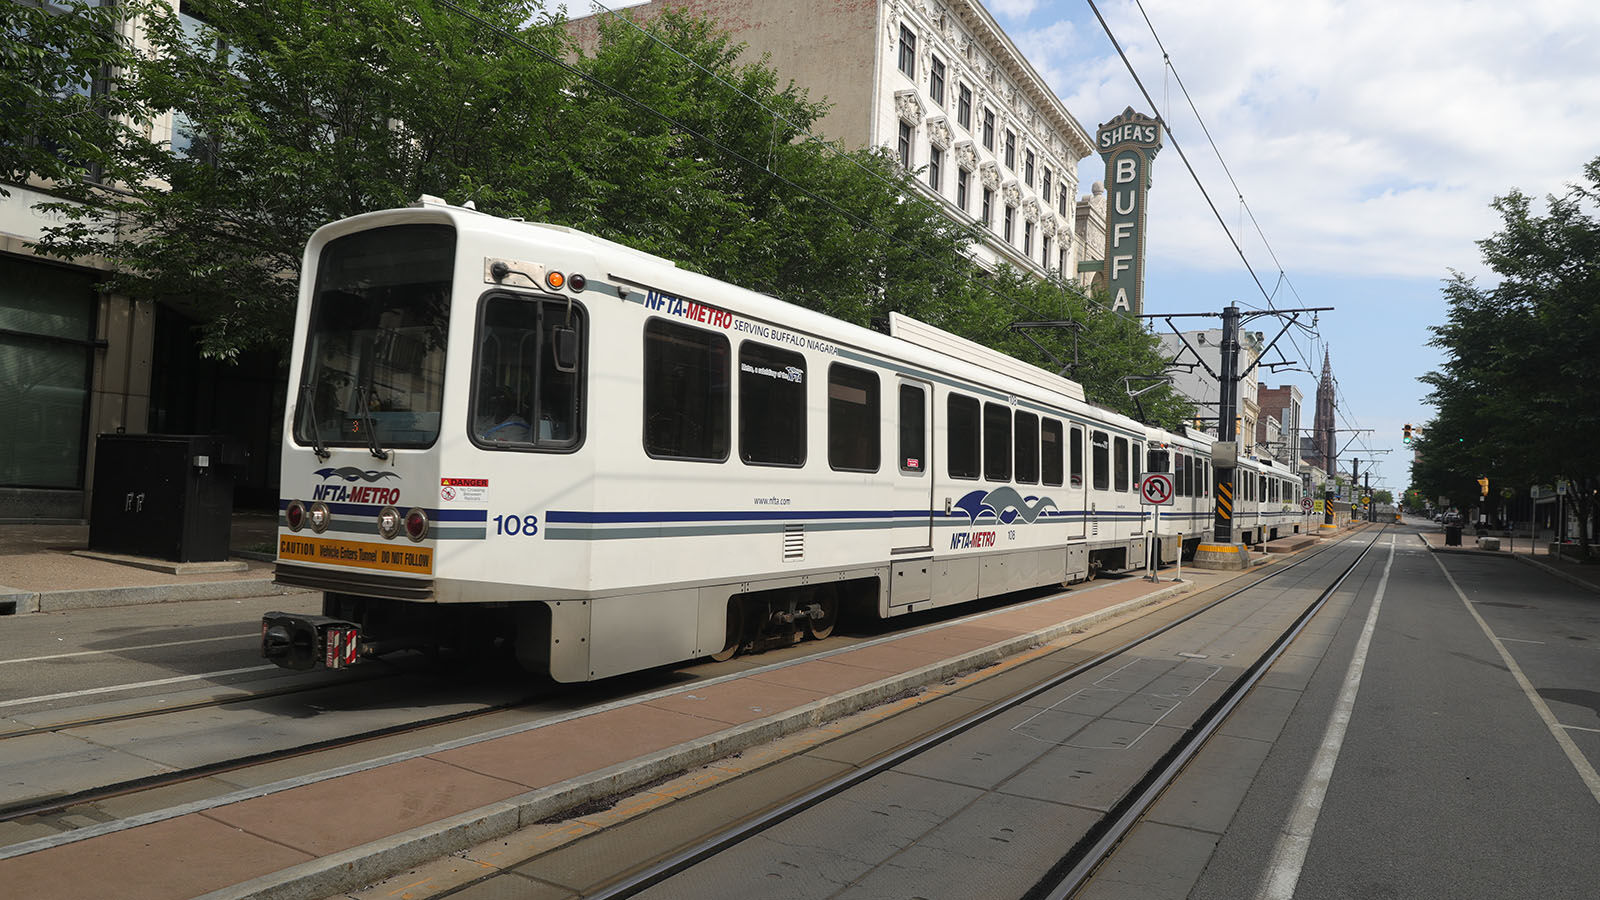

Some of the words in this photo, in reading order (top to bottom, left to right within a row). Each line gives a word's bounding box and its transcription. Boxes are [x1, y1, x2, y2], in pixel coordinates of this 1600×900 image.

[1101, 125, 1155, 147] SHEA'S
[645, 289, 733, 329] NFTA-METRO
[734, 319, 770, 338] SERVING
[771, 329, 806, 348] BUFFALO
[806, 339, 839, 356] NIAGARA
[451, 479, 488, 487] DANGER
[312, 484, 401, 505] NFTA-METRO
[753, 496, 791, 506] www.nfta.com
[493, 514, 538, 536] 108
[1008, 530, 1016, 541] 108
[949, 531, 996, 550] NFTA-METRO
[280, 540, 315, 556] CAUTION
[319, 544, 340, 560] Vehicle
[340, 546, 358, 561] Enters
[358, 548, 378, 562] Tunnel
[381, 550, 390, 563] DO
[391, 551, 404, 565] NOT
[404, 552, 430, 567] FOLLOW
